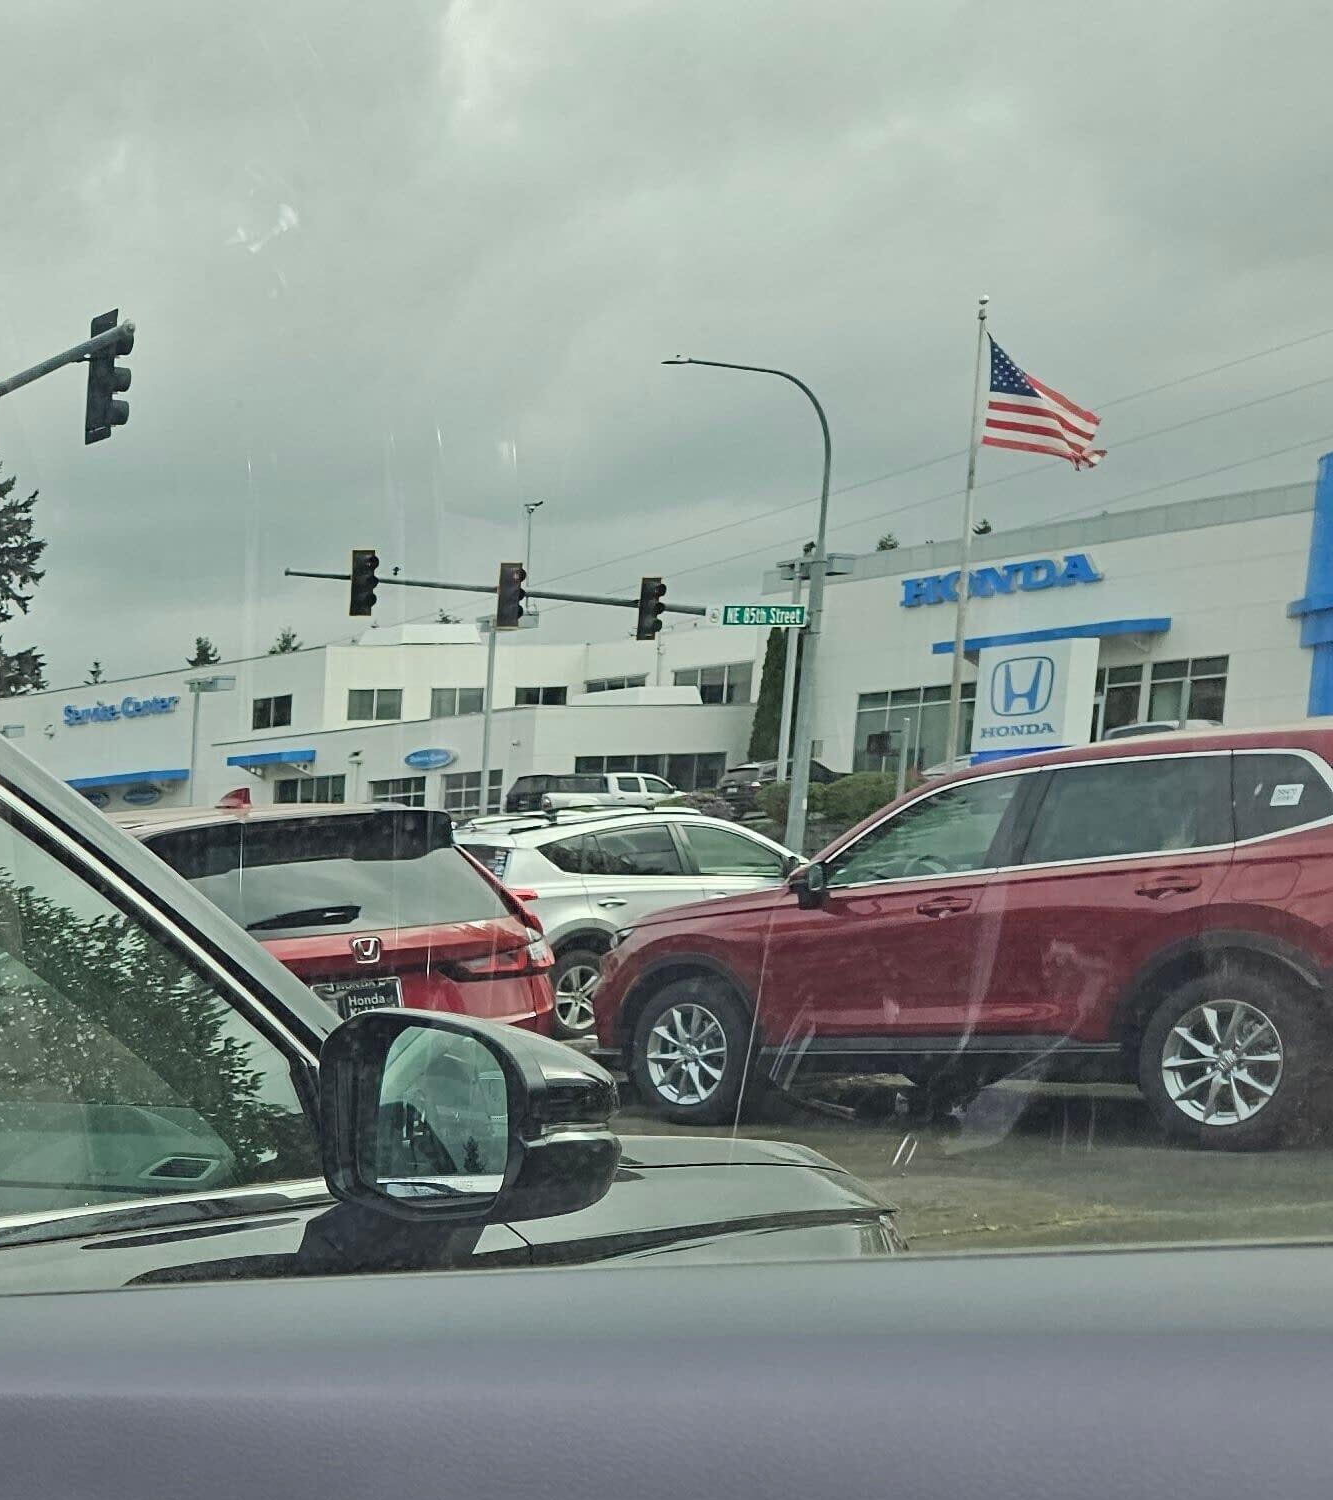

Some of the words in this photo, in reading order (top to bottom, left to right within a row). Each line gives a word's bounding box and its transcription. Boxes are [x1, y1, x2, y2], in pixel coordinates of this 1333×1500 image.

[900, 553, 1103, 607] HONDA
[727, 607, 740, 624] NE
[744, 607, 767, 624] 85th
[770, 607, 802, 624] Street
[64, 705, 120, 725] Service
[121, 696, 181, 719] Center
[980, 721, 1055, 738] HONDA
[348, 993, 386, 1006] Honda
